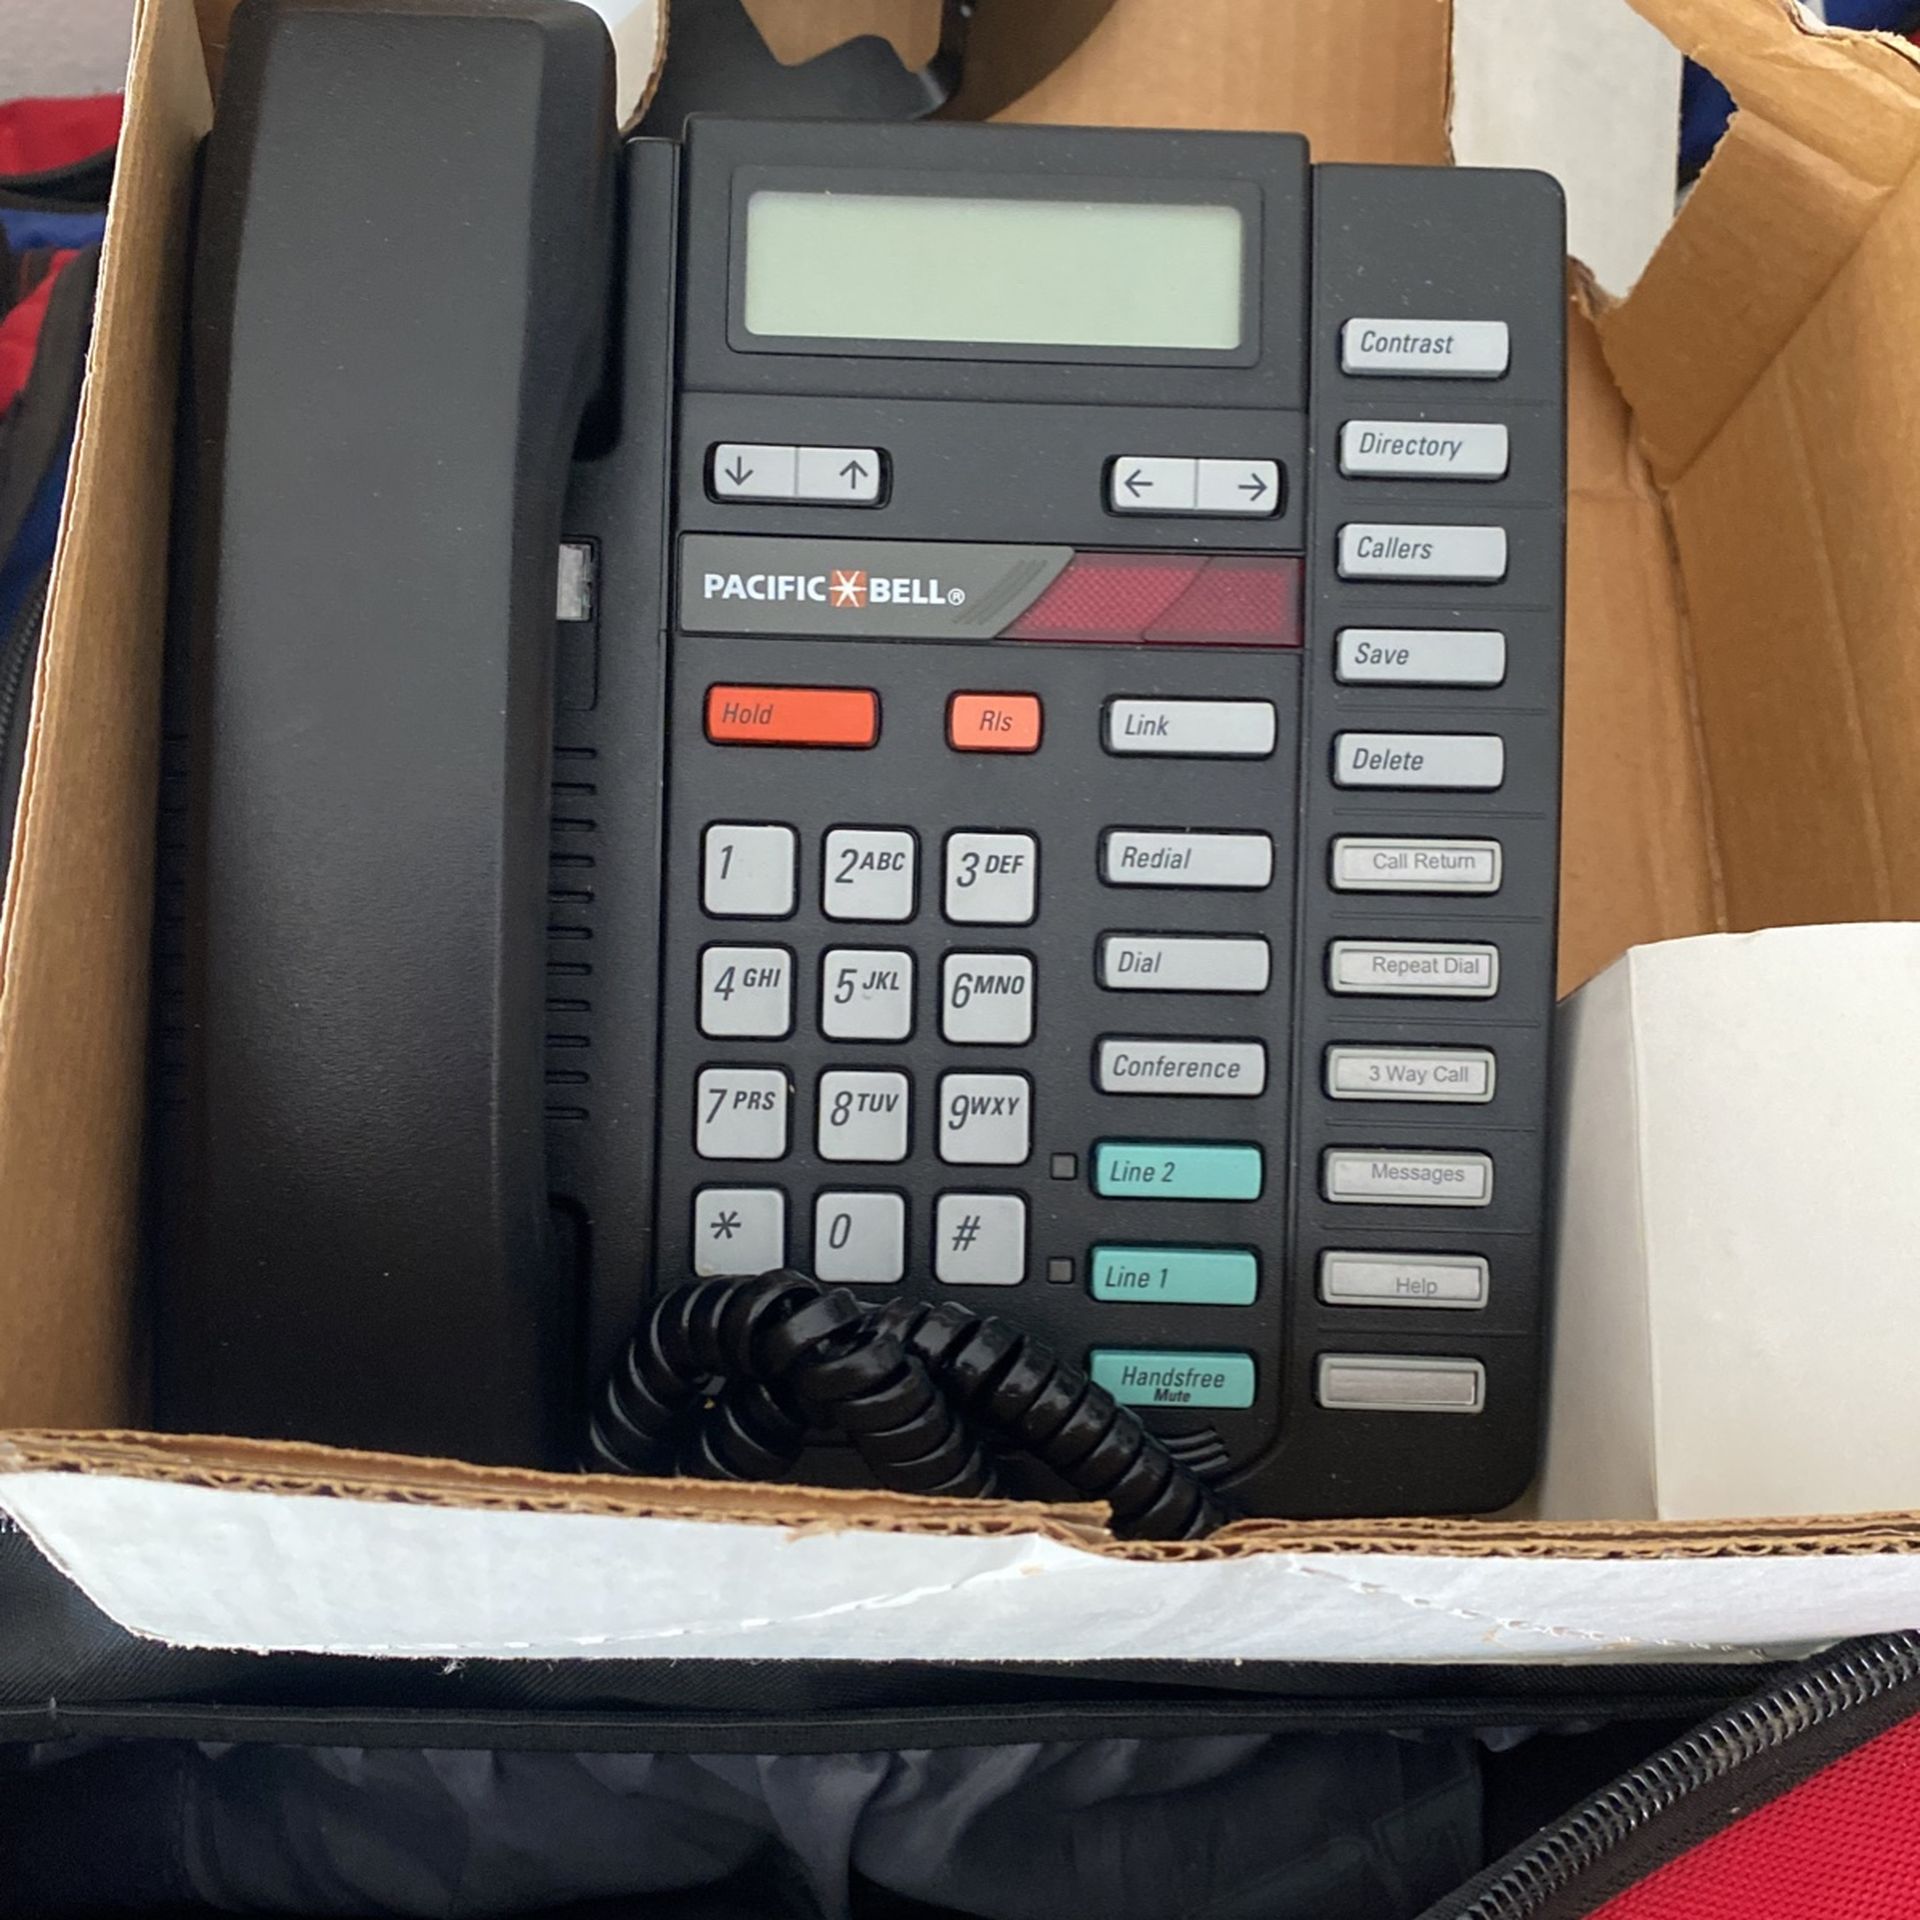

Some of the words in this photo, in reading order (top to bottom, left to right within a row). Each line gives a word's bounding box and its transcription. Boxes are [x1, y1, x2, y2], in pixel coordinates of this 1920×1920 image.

[1360, 331, 1454, 354] Contrast
[1359, 433, 1462, 461] Directory
[1357, 537, 1433, 560] Callers
[704, 574, 826, 602] PACIFIC
[1354, 644, 1409, 666] Save
[722, 703, 774, 725] Hold
[1125, 715, 1169, 736] Link
[1352, 749, 1424, 771] Delete
[720, 845, 734, 879] 1
[1121, 847, 1190, 870] Redial
[1373, 852, 1408, 870] Call
[1414, 852, 1476, 870] Return
[1118, 952, 1160, 973] Dial
[1372, 956, 1438, 976] Repeat
[1444, 956, 1479, 974] Dial
[1112, 1056, 1240, 1080] Conference
[1369, 1066, 1380, 1083] 3
[1386, 1066, 1426, 1087] Way
[1433, 1066, 1468, 1084] Call
[1110, 1161, 1154, 1183] Line
[1160, 1162, 1174, 1183] 2
[1372, 1164, 1464, 1187] Messages
[1106, 1267, 1149, 1289] Line
[1160, 1268, 1168, 1289] 1
[1396, 1276, 1438, 1298] Help
[1121, 1366, 1225, 1389] Handsfree
[1154, 1388, 1190, 1404] Mute
